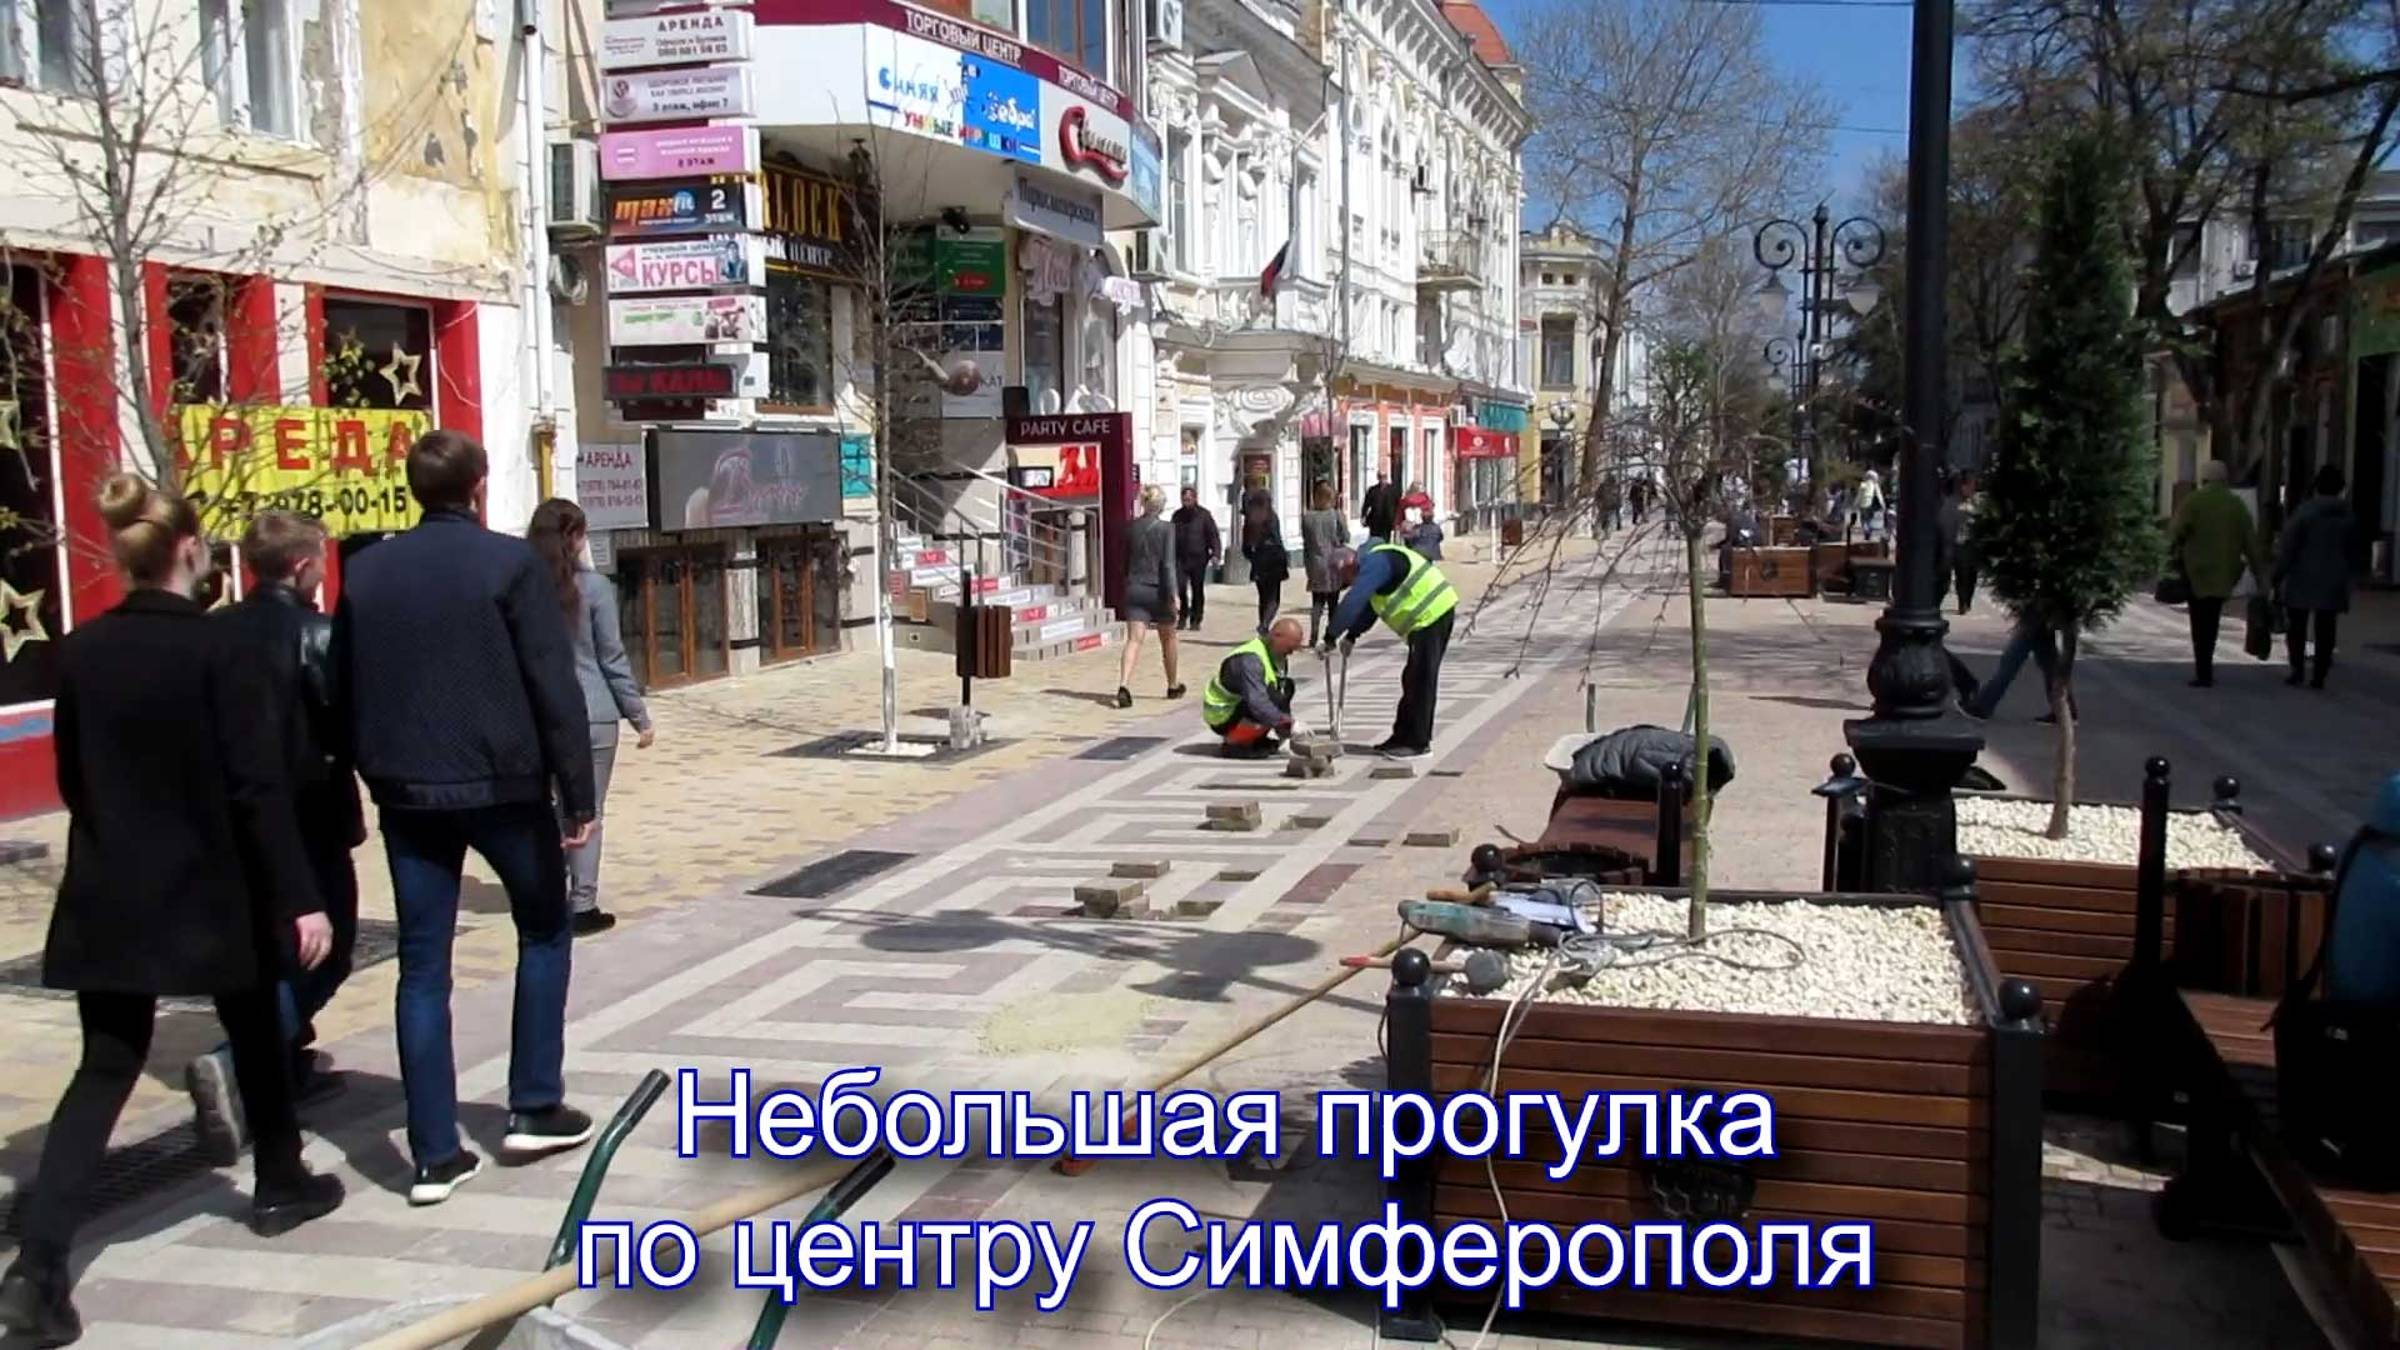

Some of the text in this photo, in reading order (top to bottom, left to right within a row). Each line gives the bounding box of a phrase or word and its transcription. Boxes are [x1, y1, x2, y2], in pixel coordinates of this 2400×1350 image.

[658, 16, 724, 32] АРЕНДА
[905, 9, 1021, 64] ТОРГОВЫЙ ЦЕНТР
[711, 189, 726, 210] 2
[641, 260, 721, 288] КУРСЫ
[1021, 419, 1111, 437] PARTY CAFE
[585, 451, 633, 470] АРЕНДА
